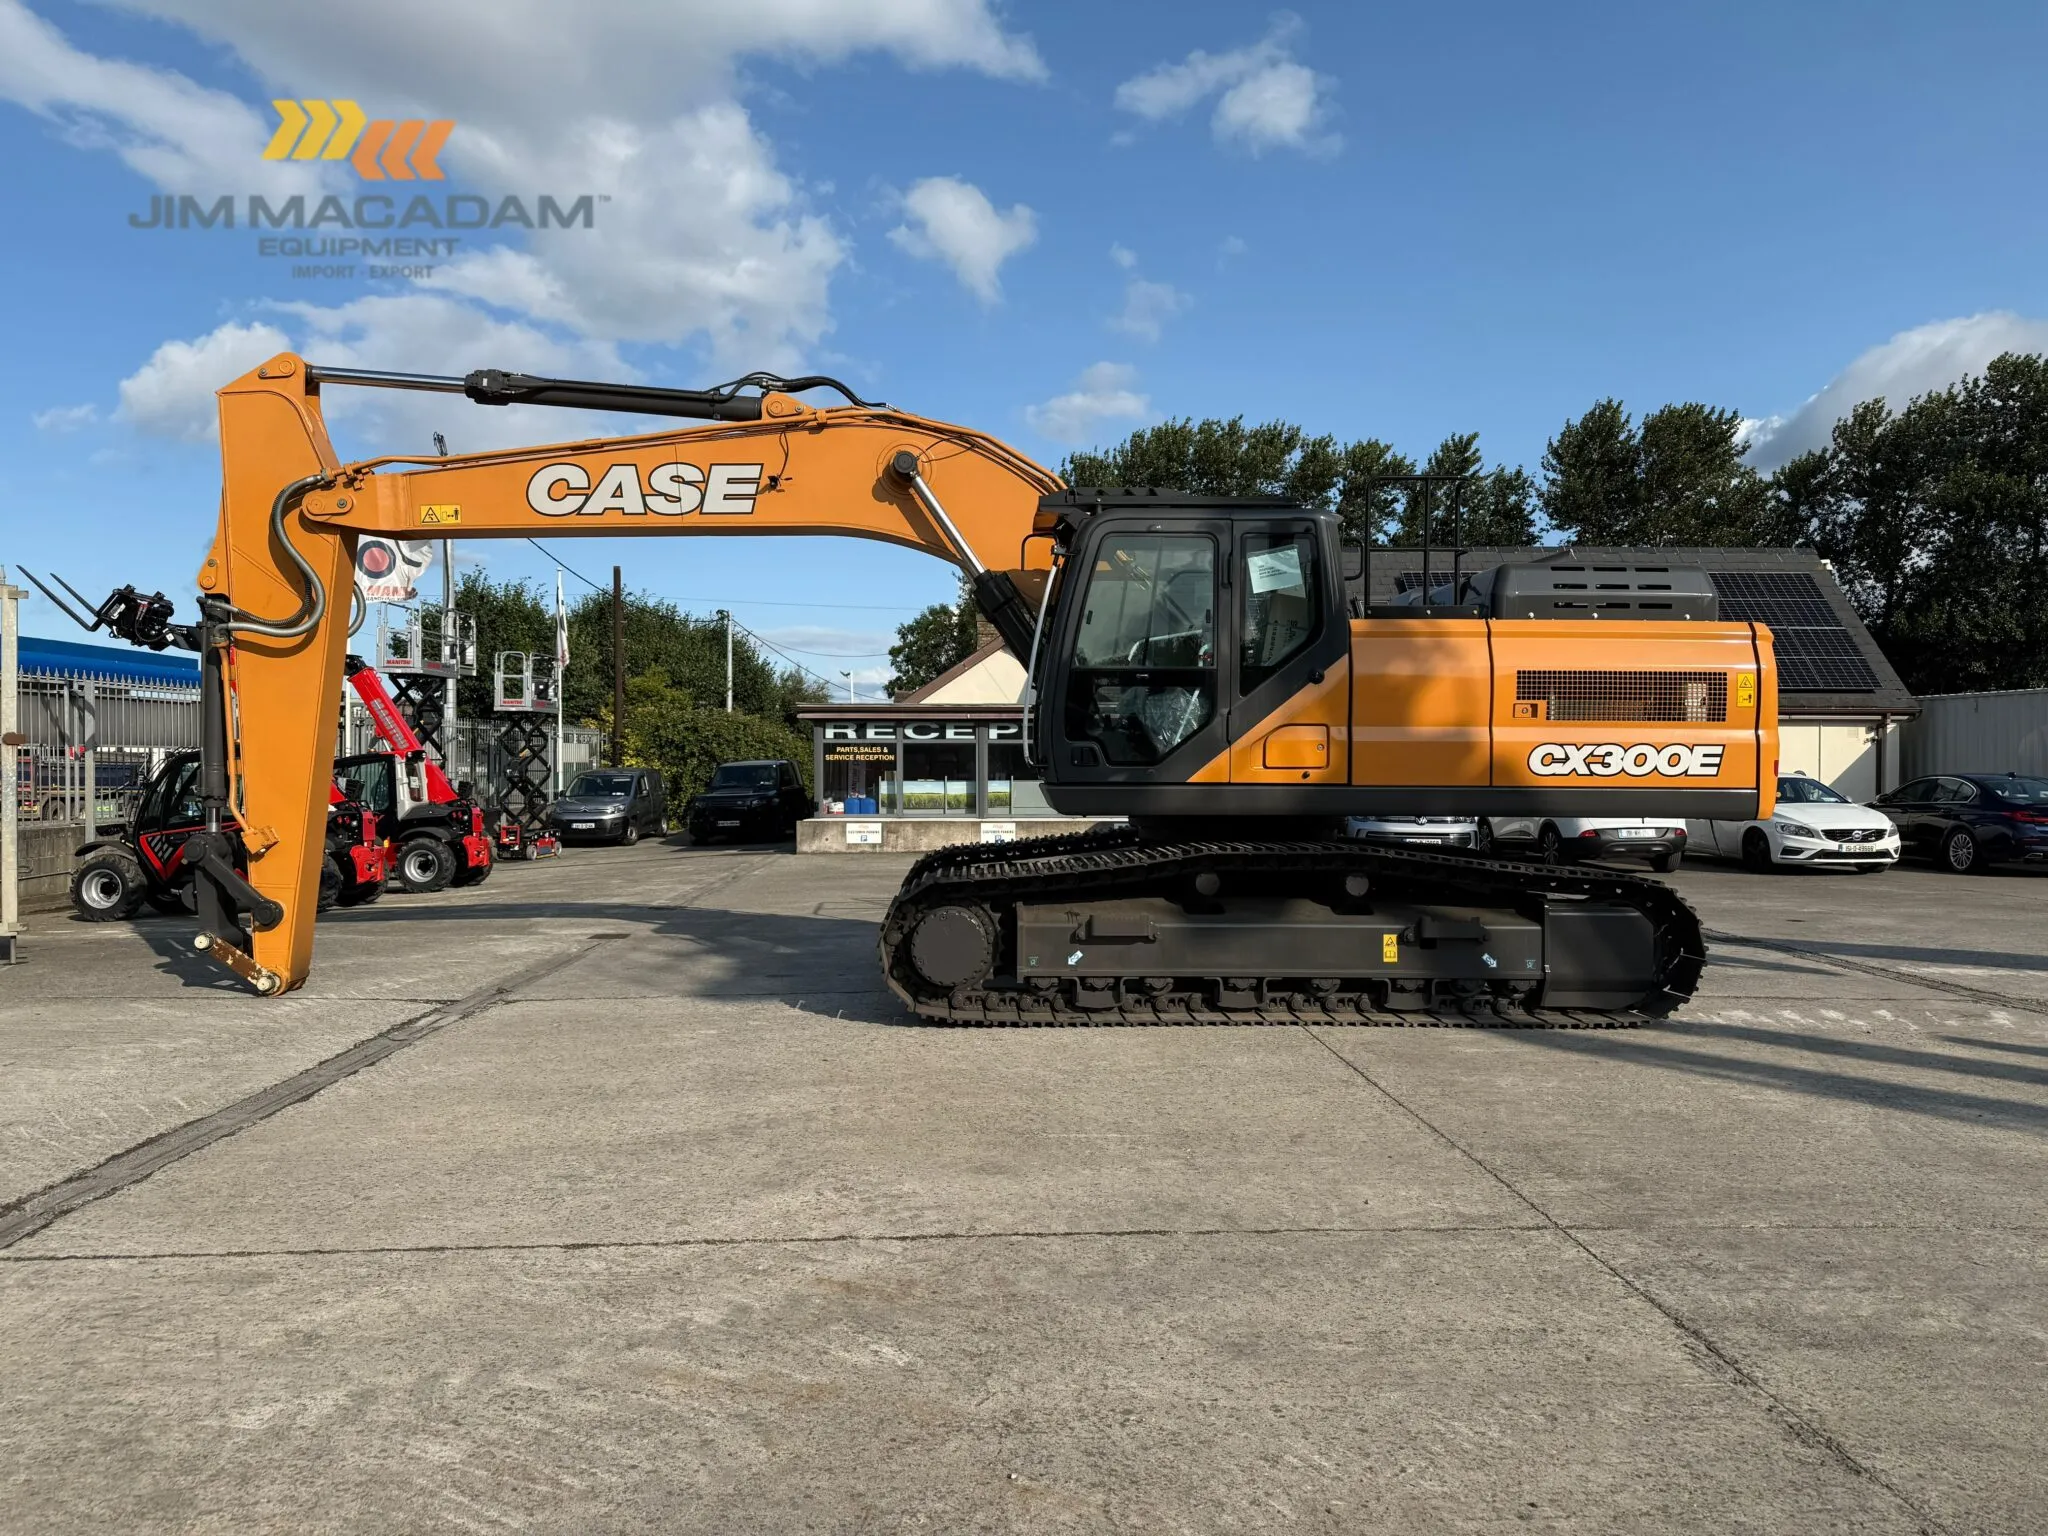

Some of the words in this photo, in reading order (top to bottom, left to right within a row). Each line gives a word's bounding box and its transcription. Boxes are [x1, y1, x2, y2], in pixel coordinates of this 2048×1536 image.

[525, 462, 764, 517] CASE
[824, 754, 855, 762] SERVICE
[855, 754, 895, 762] RECEPTION
[1527, 742, 1726, 778] CX300E
